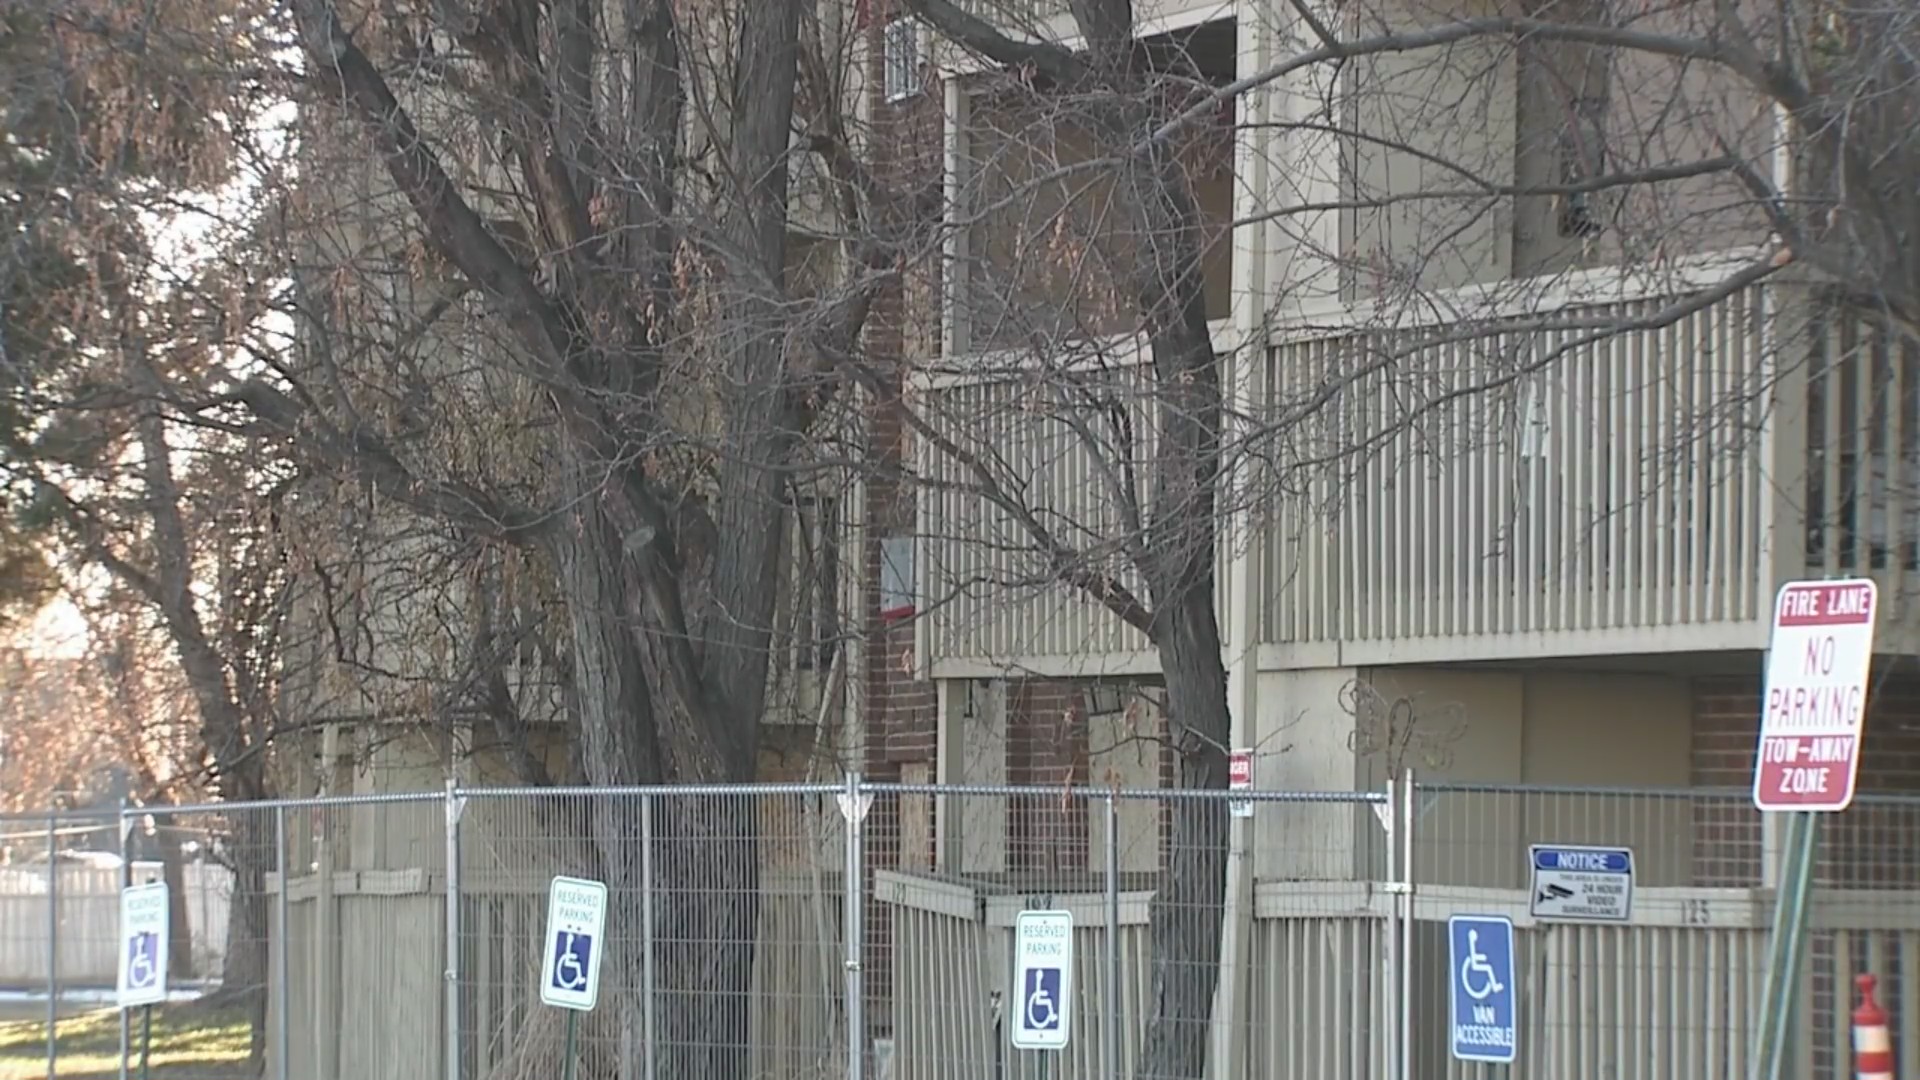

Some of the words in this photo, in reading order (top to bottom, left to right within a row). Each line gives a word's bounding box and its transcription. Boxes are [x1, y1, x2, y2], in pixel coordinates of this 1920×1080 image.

[1781, 589, 1821, 617] FIRE
[1826, 587, 1870, 616] LANE
[1804, 635, 1835, 676] NO
[1767, 685, 1860, 728] PARKING
[1764, 736, 1853, 763] TOW-AWAY
[1778, 766, 1830, 794] ZONE
[1557, 851, 1608, 870] NOTICE
[557, 889, 599, 908] RESERVED
[1582, 883, 1594, 893] 24
[1596, 884, 1624, 895] HOUR
[1587, 895, 1617, 906] VIDEO
[559, 906, 595, 924] PARKING
[1561, 905, 1619, 916] SURVEILLANCE
[1681, 899, 1711, 925] 125
[1023, 925, 1066, 938] RESERVED
[1026, 942, 1062, 955] PARKING
[1472, 1005, 1495, 1025] VAN
[1456, 1024, 1512, 1047] ACCESSIBLE
